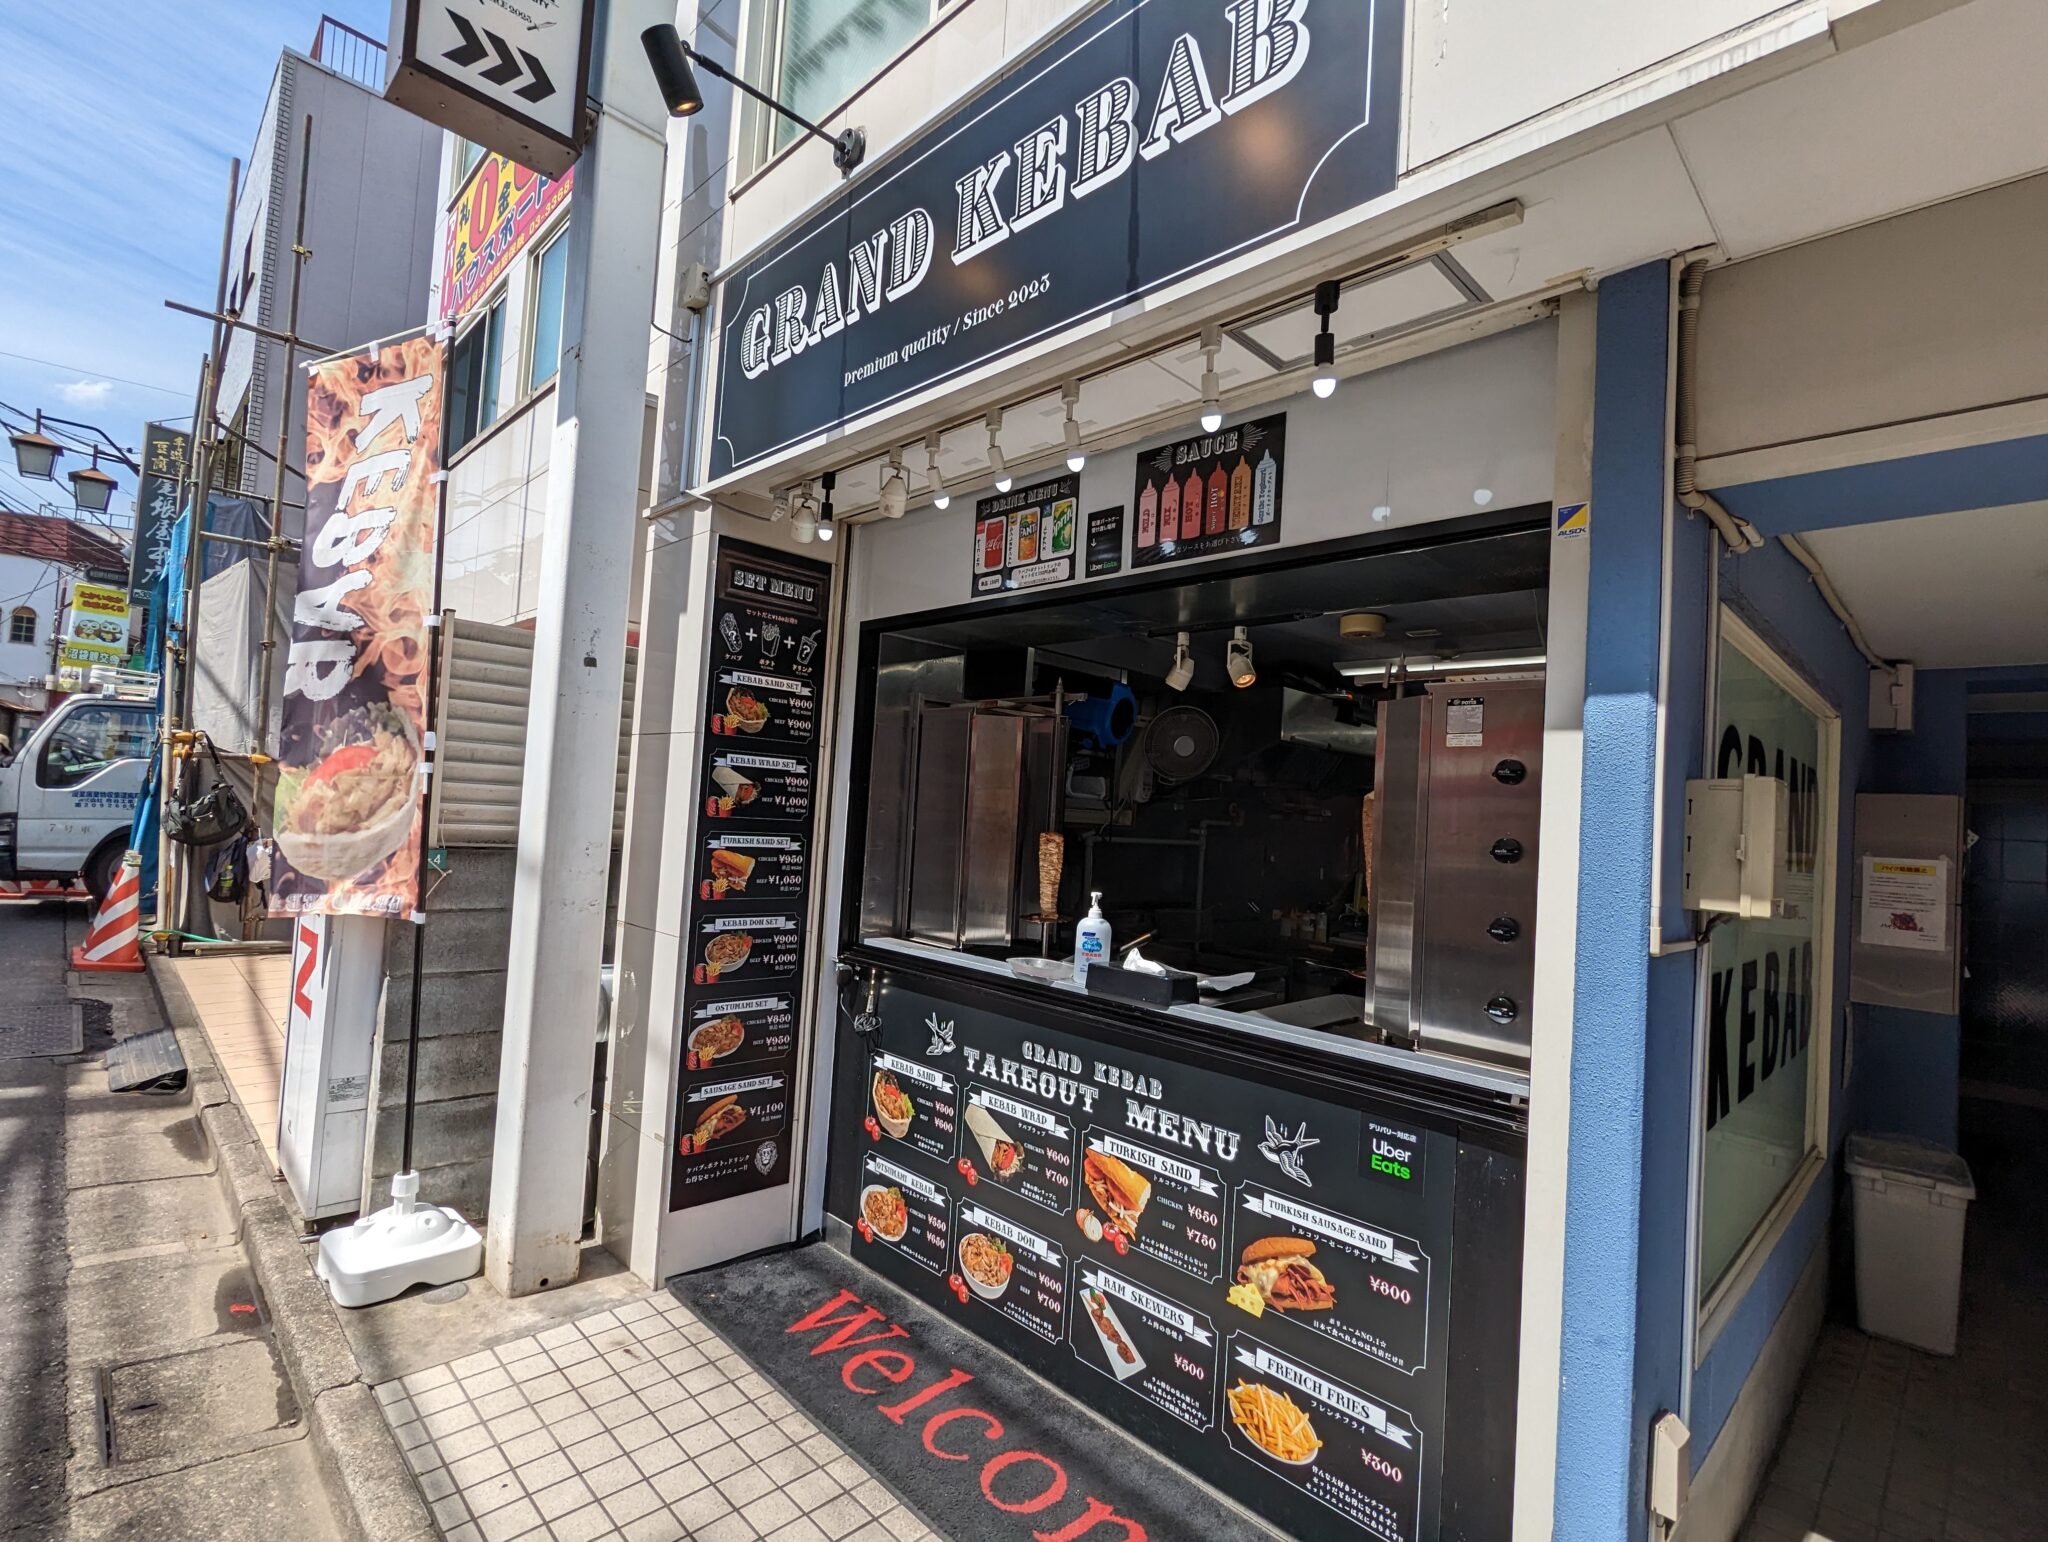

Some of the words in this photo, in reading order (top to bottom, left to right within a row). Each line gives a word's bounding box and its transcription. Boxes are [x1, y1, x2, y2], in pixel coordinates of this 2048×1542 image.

[742, 208, 934, 379] GRAND
[951, 0, 1311, 264] KEBAB
[469, 158, 499, 252] 0
[844, 348, 898, 387] premium
[901, 324, 951, 364] quality
[963, 298, 1004, 333] Since
[1008, 273, 1050, 310] 2023
[152, 441, 170, 472] 豆腐
[1176, 431, 1238, 464] SAUCE
[992, 493, 1026, 513] DRINK
[1028, 483, 1058, 503] MENU
[1210, 487, 1218, 508] HOT
[1142, 508, 1150, 533] MILD
[1185, 501, 1193, 522] HOT
[1558, 527, 1586, 537] ALSOK
[1090, 563, 1103, 571] Uber
[1103, 561, 1118, 569] Eats
[734, 569, 767, 591] SET
[770, 577, 814, 602] MENU
[737, 674, 763, 686] KEBAB
[764, 678, 785, 689] SAND
[785, 681, 800, 691] SET
[789, 697, 813, 709] ¥800
[787, 719, 811, 730] ¥900
[730, 755, 757, 766] KEBAB
[758, 759, 781, 769] WRAP
[782, 761, 796, 769] SET
[785, 776, 809, 787] ¥900
[774, 795, 808, 808] ¥1,000
[722, 837, 754, 846] TURKISH
[755, 837, 775, 846] SAND
[776, 838, 790, 846] SET
[778, 854, 803, 865] ¥950
[768, 875, 802, 886] ¥1,050
[722, 919, 748, 927] KEBAB
[765, 917, 779, 926] SET
[773, 934, 798, 944] ¥900
[763, 953, 796, 965] ¥1,000
[755, 999, 768, 1008] SET
[767, 1014, 791, 1024] ¥850
[765, 1034, 791, 1045] ¥950
[1707, 940, 1813, 1131] KEBAB
[890, 1059, 914, 1076] KEBAB
[916, 1067, 936, 1083] SAND
[1022, 1040, 1082, 1074] GRAND
[1094, 1061, 1163, 1100] KEBAB
[704, 1080, 737, 1095] SAUSAGE
[737, 1078, 756, 1090] SAND
[757, 1076, 772, 1087] SET
[750, 1102, 784, 1116] ¥1,100
[935, 1101, 954, 1117] ¥500
[963, 1046, 1099, 1113] TAKEOUT
[1125, 1099, 1241, 1162] MENU
[988, 1096, 1017, 1115] KEBAB
[1021, 1107, 1048, 1125] WRAP
[934, 1117, 953, 1133] ¥600
[1368, 1122, 1417, 1143] デリバリー対応店
[1046, 1149, 1070, 1166] ¥600
[1109, 1140, 1157, 1168] TURKISH
[1160, 1161, 1193, 1181] SAND
[1372, 1138, 1411, 1163] Uber
[876, 1161, 908, 1181] OTSUMAMI
[911, 1177, 933, 1196] KEBAB
[1045, 1168, 1069, 1187] ¥700
[1371, 1154, 1411, 1180] Eats
[1153, 1174, 1189, 1194] トルコサンド
[928, 1213, 947, 1232] ¥550
[1156, 1195, 1184, 1211] CHICKEN
[1187, 1203, 1218, 1227] ¥650
[984, 1215, 1014, 1238] KEBAB
[1161, 1219, 1176, 1231] BEEF
[1186, 1226, 1217, 1250] ¥750
[1268, 1199, 1310, 1223] TURKISH
[1311, 1214, 1357, 1241] SAUSAGE
[1358, 1231, 1388, 1251] SAND
[926, 1230, 945, 1249] ¥650
[1290, 1224, 1379, 1263] トルコソーセージサンド
[1038, 1271, 1062, 1294] ¥600
[1369, 1275, 1411, 1304] ¥800
[1037, 1290, 1061, 1313] ¥700
[1103, 1276, 1126, 1297] RAM
[1130, 1290, 1185, 1327] SKEWERS
[1173, 1353, 1205, 1381] ¥500
[1266, 1356, 1323, 1396] FRENCH
[1327, 1387, 1371, 1420] FRIES
[1310, 1399, 1366, 1435] フレンチフライ
[1360, 1447, 1403, 1483] ¥300
